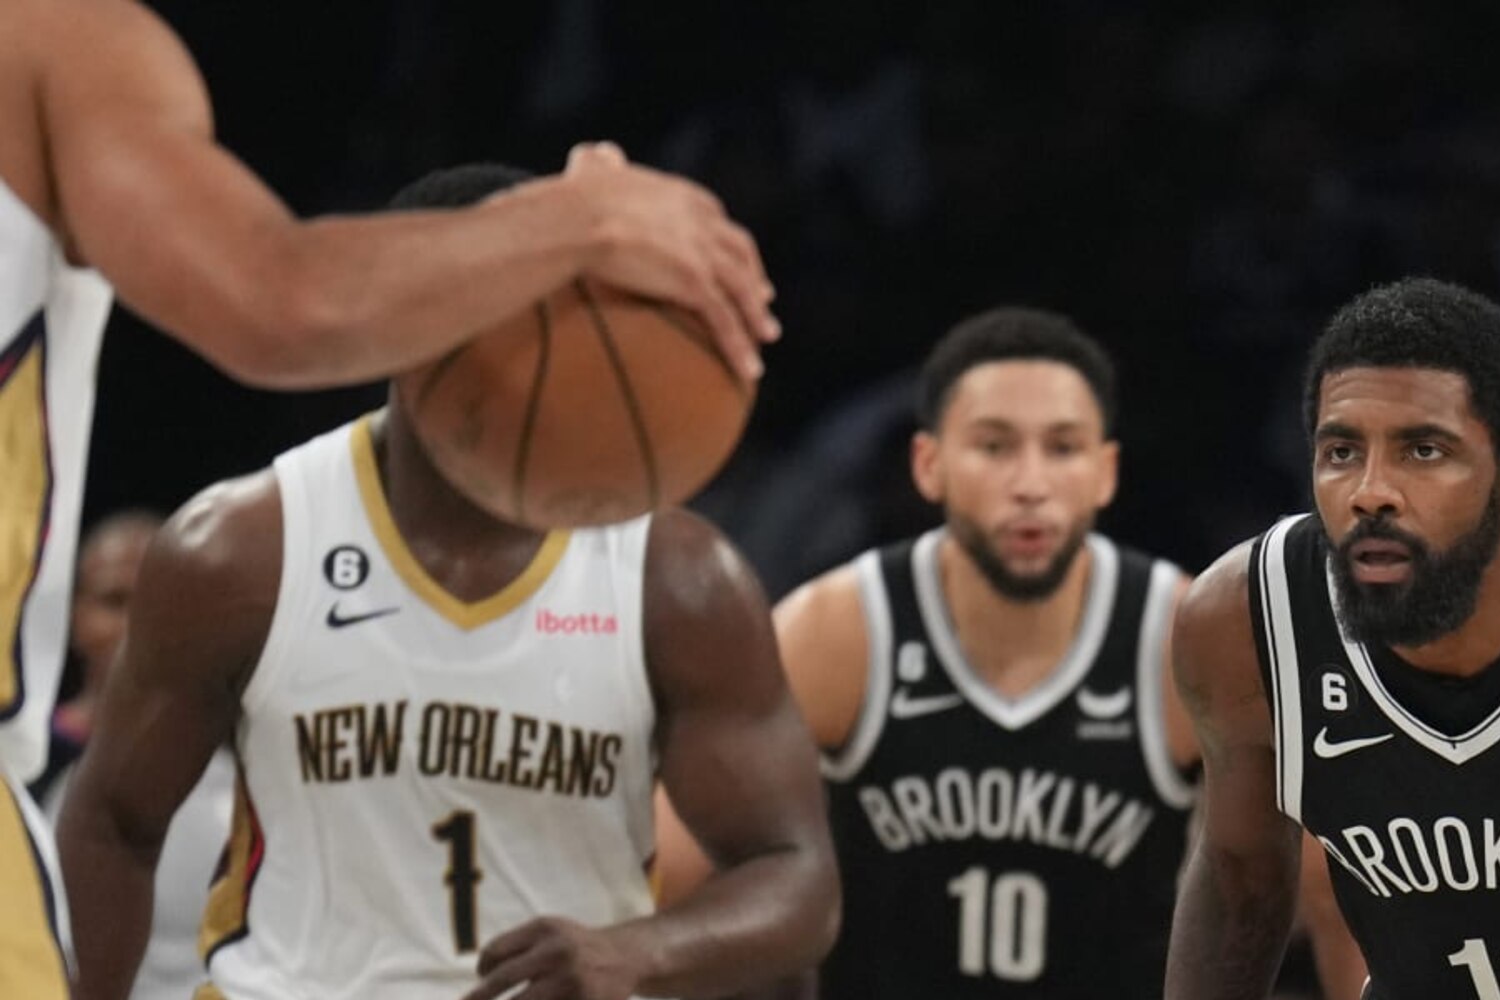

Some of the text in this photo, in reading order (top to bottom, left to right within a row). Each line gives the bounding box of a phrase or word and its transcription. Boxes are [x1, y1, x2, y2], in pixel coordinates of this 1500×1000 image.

[333, 549, 362, 585] 6
[535, 608, 618, 636] ibotta
[1322, 672, 1348, 711] 6
[293, 699, 623, 800] NEW ORLEANS
[858, 767, 1155, 870] BROOKLYN
[432, 809, 483, 955] 1
[947, 867, 1049, 982] 10
